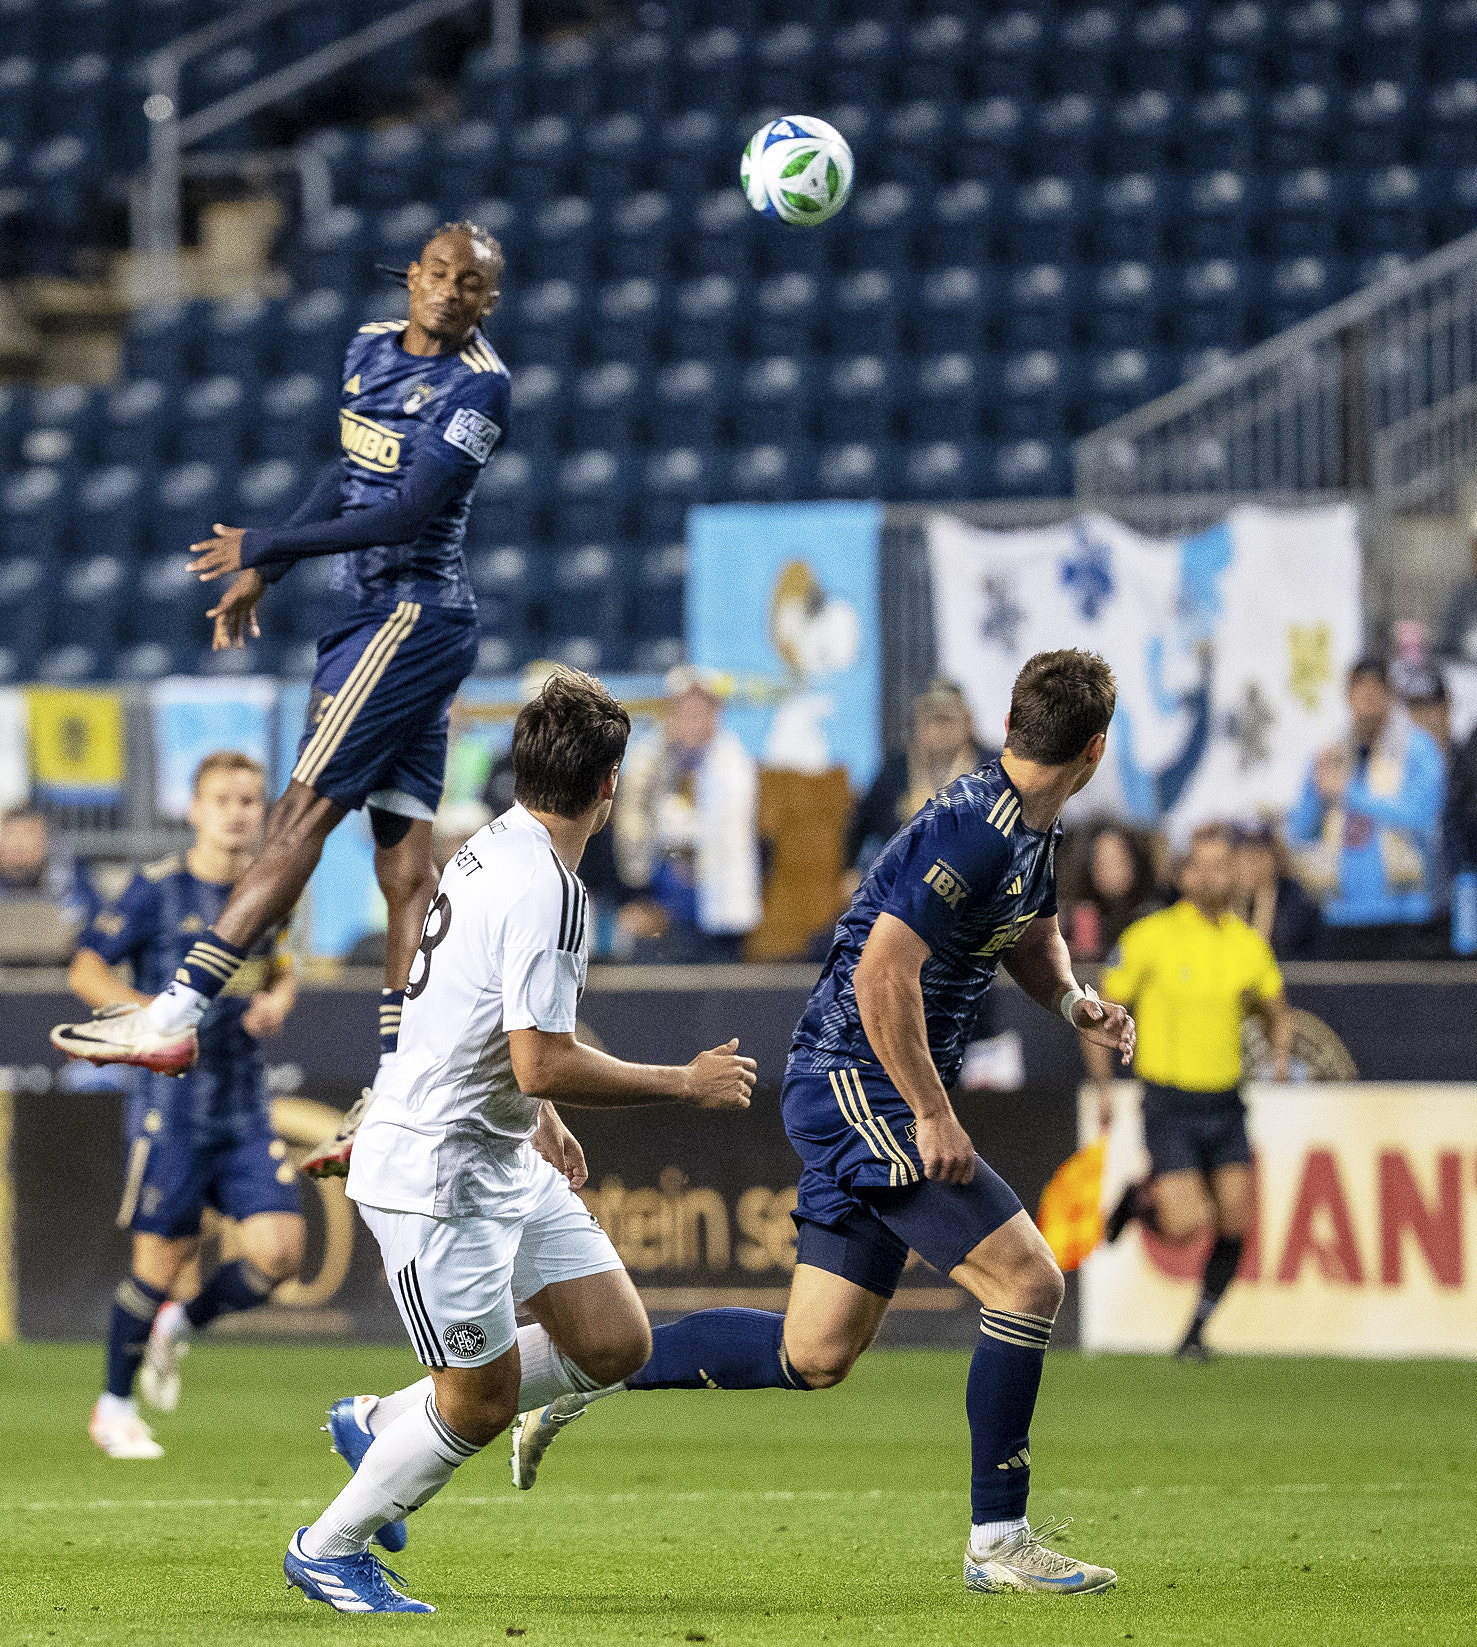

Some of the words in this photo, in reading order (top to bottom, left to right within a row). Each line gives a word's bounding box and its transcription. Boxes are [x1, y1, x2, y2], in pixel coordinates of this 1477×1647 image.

[341, 416, 401, 468] MBO
[922, 863, 968, 911] IBX
[1140, 1144, 1477, 1288] IAN
